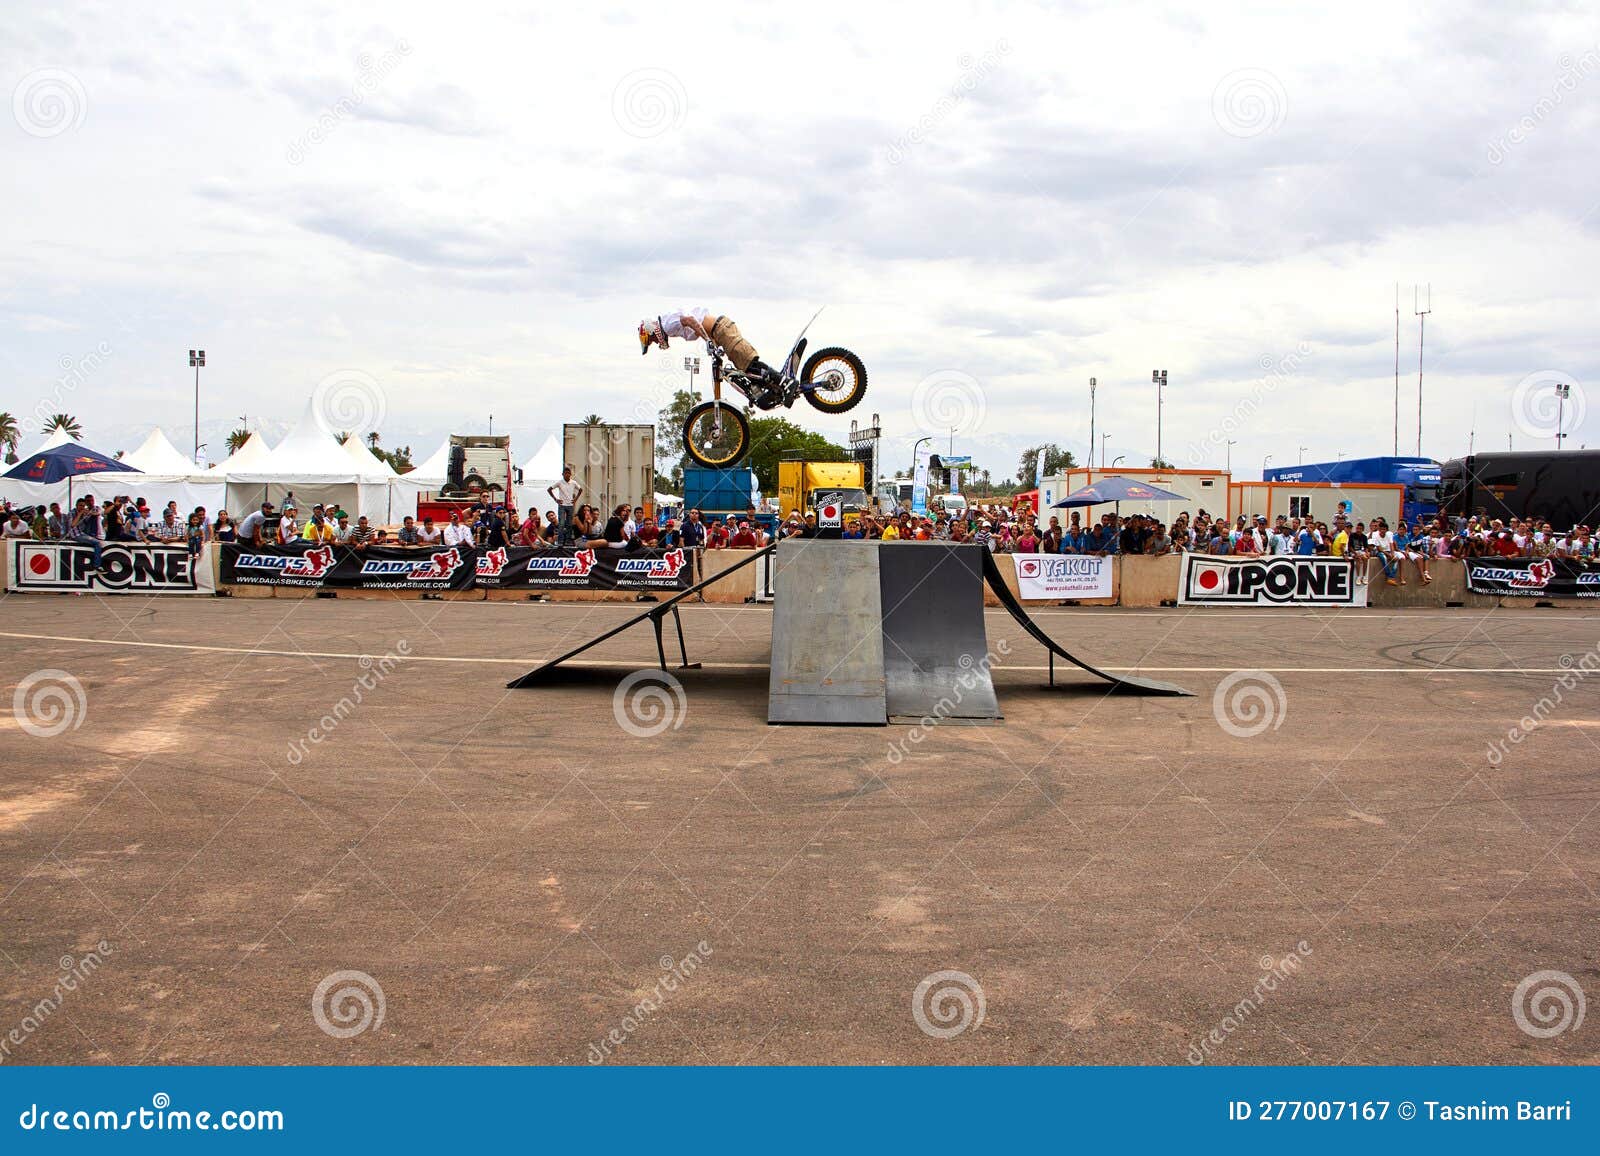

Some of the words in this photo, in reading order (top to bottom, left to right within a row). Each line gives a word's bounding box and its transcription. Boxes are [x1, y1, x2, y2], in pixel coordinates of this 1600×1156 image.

[60, 549, 190, 584] IPONE
[236, 554, 307, 569] DADA'S
[362, 560, 434, 573] DADA'S
[528, 558, 578, 571] DADA'S
[616, 559, 666, 573] DADA'S
[1042, 558, 1103, 577] YAKUT
[1227, 564, 1347, 596] IPONE
[1472, 567, 1531, 581] DADA'S
